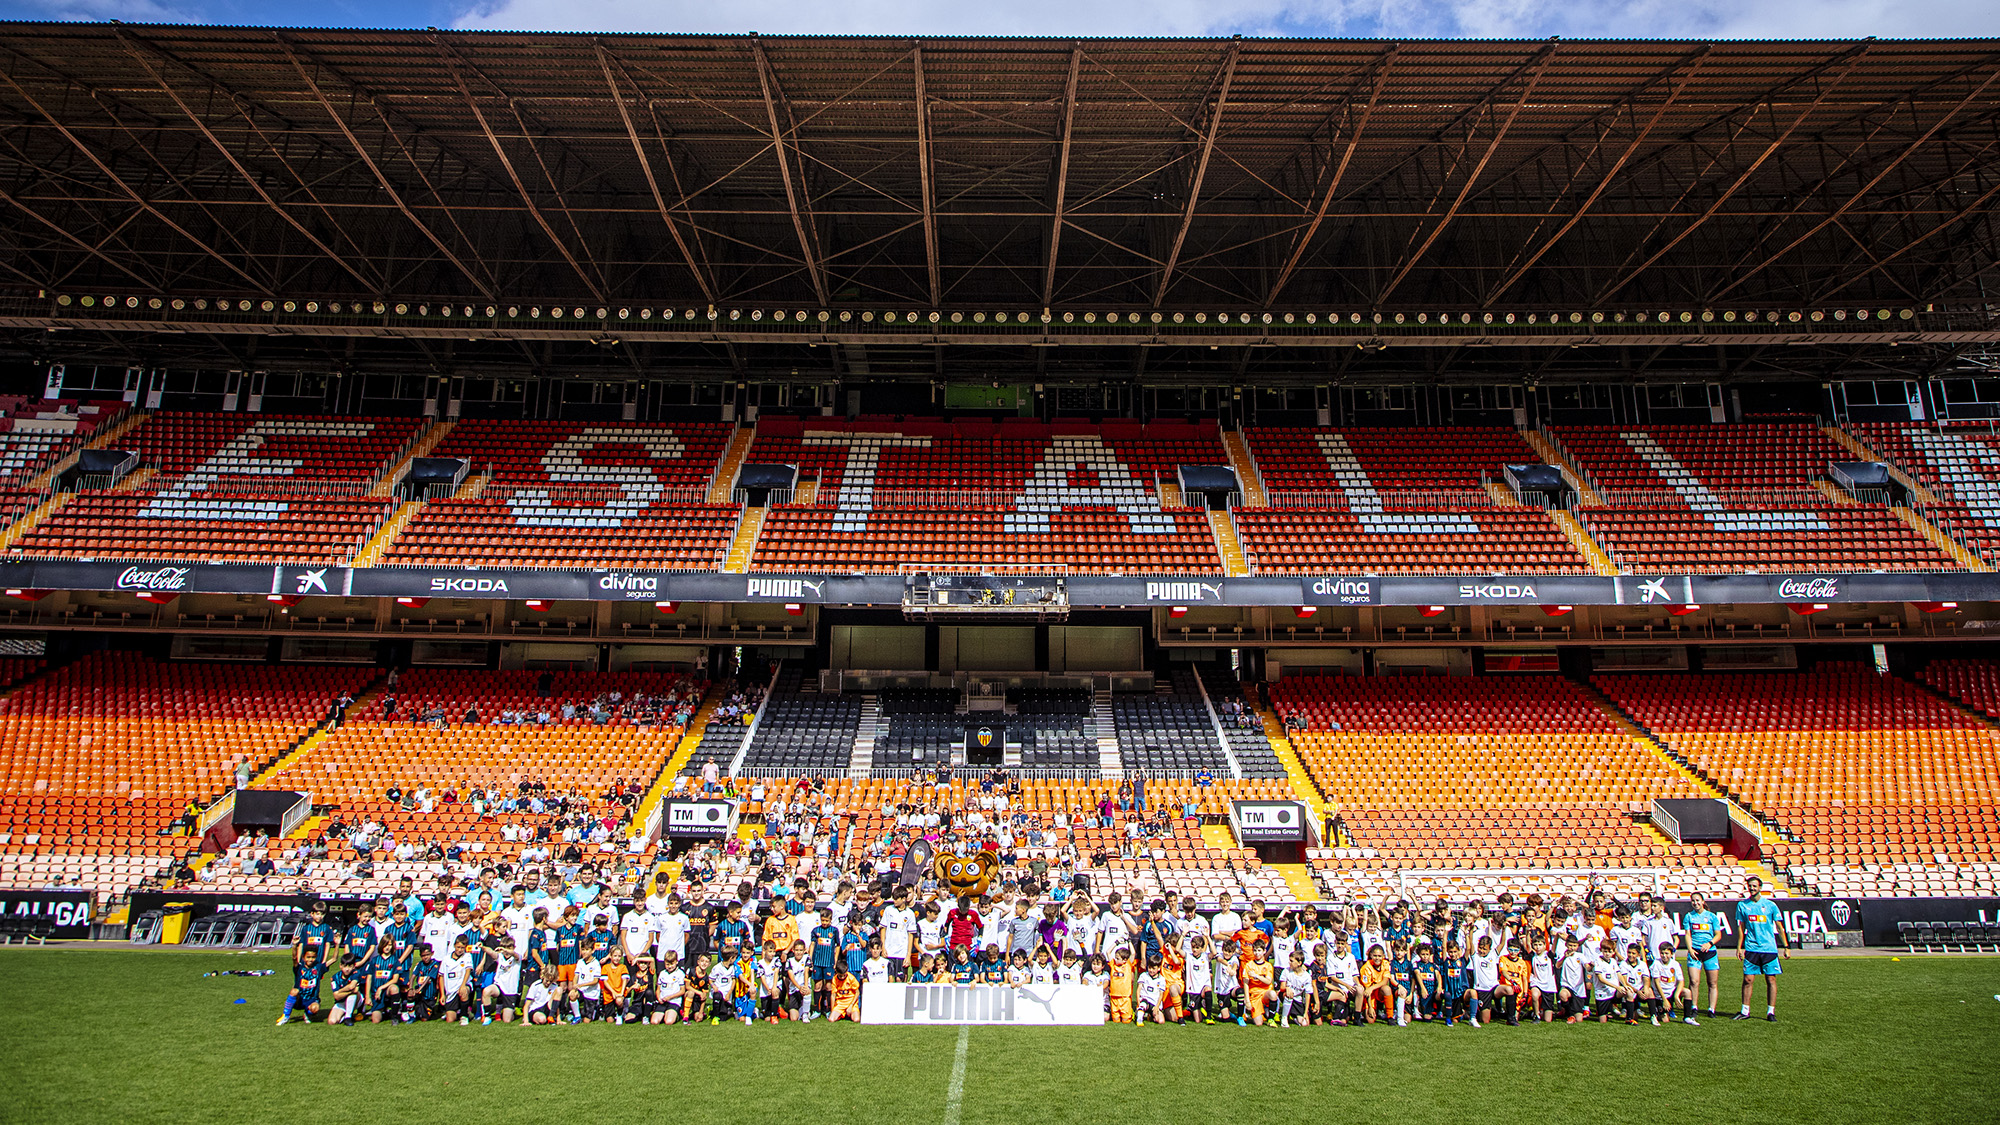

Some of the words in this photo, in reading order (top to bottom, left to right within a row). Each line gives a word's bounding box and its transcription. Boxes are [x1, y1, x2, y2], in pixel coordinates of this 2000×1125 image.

[599, 573, 658, 592] divina
[1312, 577, 1371, 596] divina
[626, 591, 657, 600] seguros
[1341, 595, 1371, 604] seguros
[674, 809, 693, 820] TM
[1245, 812, 1264, 823] TM
[692, 825, 709, 833] Estate
[710, 826, 726, 834] Group
[1265, 828, 1281, 836] Estate
[1282, 828, 1300, 836] Group
[903, 986, 1015, 1021] PUMA
